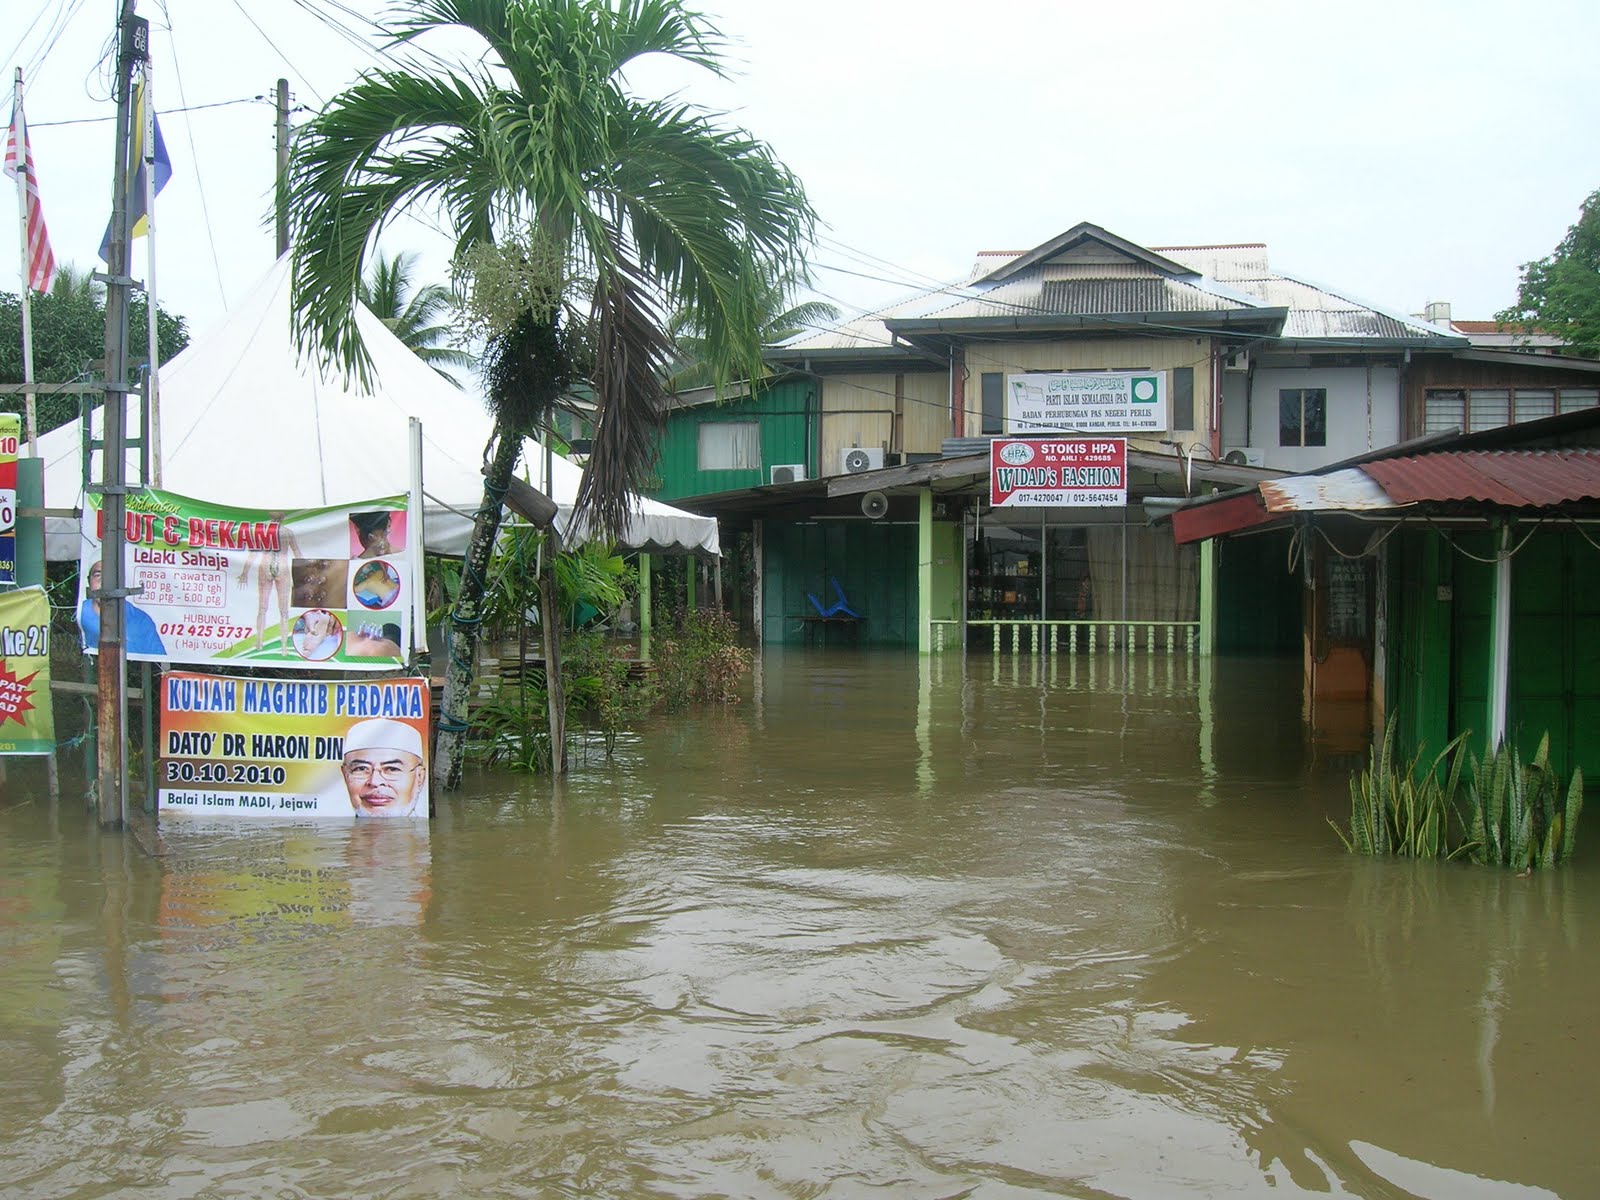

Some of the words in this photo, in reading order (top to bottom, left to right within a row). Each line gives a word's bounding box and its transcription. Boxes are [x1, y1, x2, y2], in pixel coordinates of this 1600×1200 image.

[1045, 394, 1061, 406] PARTI
[1063, 394, 1080, 405] ISLAM
[1081, 394, 1114, 405] SEMALAYSIA
[1022, 411, 1042, 419] BADAN
[1045, 410, 1088, 418] PERHUBUNGAN
[1090, 410, 1102, 418] PAS
[1104, 409, 1127, 417] NEGERI
[1130, 409, 1152, 417] PERLIS
[0, 436, 17, 454] 10
[1041, 443, 1087, 455] STOKIS
[1092, 443, 1116, 454] HPA
[1007, 449, 1028, 459] HPA
[1061, 466, 1121, 487] FASHION
[1018, 493, 1064, 503] 017-4270047
[163, 515, 181, 546] &
[188, 517, 280, 551] BEKAM
[134, 548, 176, 565] Lelaki
[182, 551, 229, 570] Sahaja
[139, 571, 166, 580] masa
[173, 573, 221, 582] rawatan
[160, 582, 172, 592] pg
[182, 582, 204, 591] 12.30
[207, 583, 222, 593] tgh
[158, 593, 174, 603] ptg
[184, 593, 203, 603] 6.00
[205, 595, 221, 606] ptg
[183, 614, 231, 625] HUBUNGI
[160, 623, 184, 636] 012
[187, 625, 213, 637] 425
[217, 625, 253, 639] 5737
[182, 640, 199, 651] Haji
[202, 640, 227, 649] Yusuf
[168, 677, 236, 712] KULIAH
[244, 681, 328, 715] MAGHRIB
[335, 683, 424, 718] PERDANA
[168, 730, 218, 756] DATO'
[223, 733, 245, 757] DR
[252, 735, 309, 760] HARON
[315, 736, 344, 760] DIN
[167, 762, 286, 785] 30.10.2010
[167, 792, 198, 806] Balai
[202, 794, 235, 807] Islam
[238, 795, 276, 810] MADI,
[279, 795, 318, 811] Jejawi
